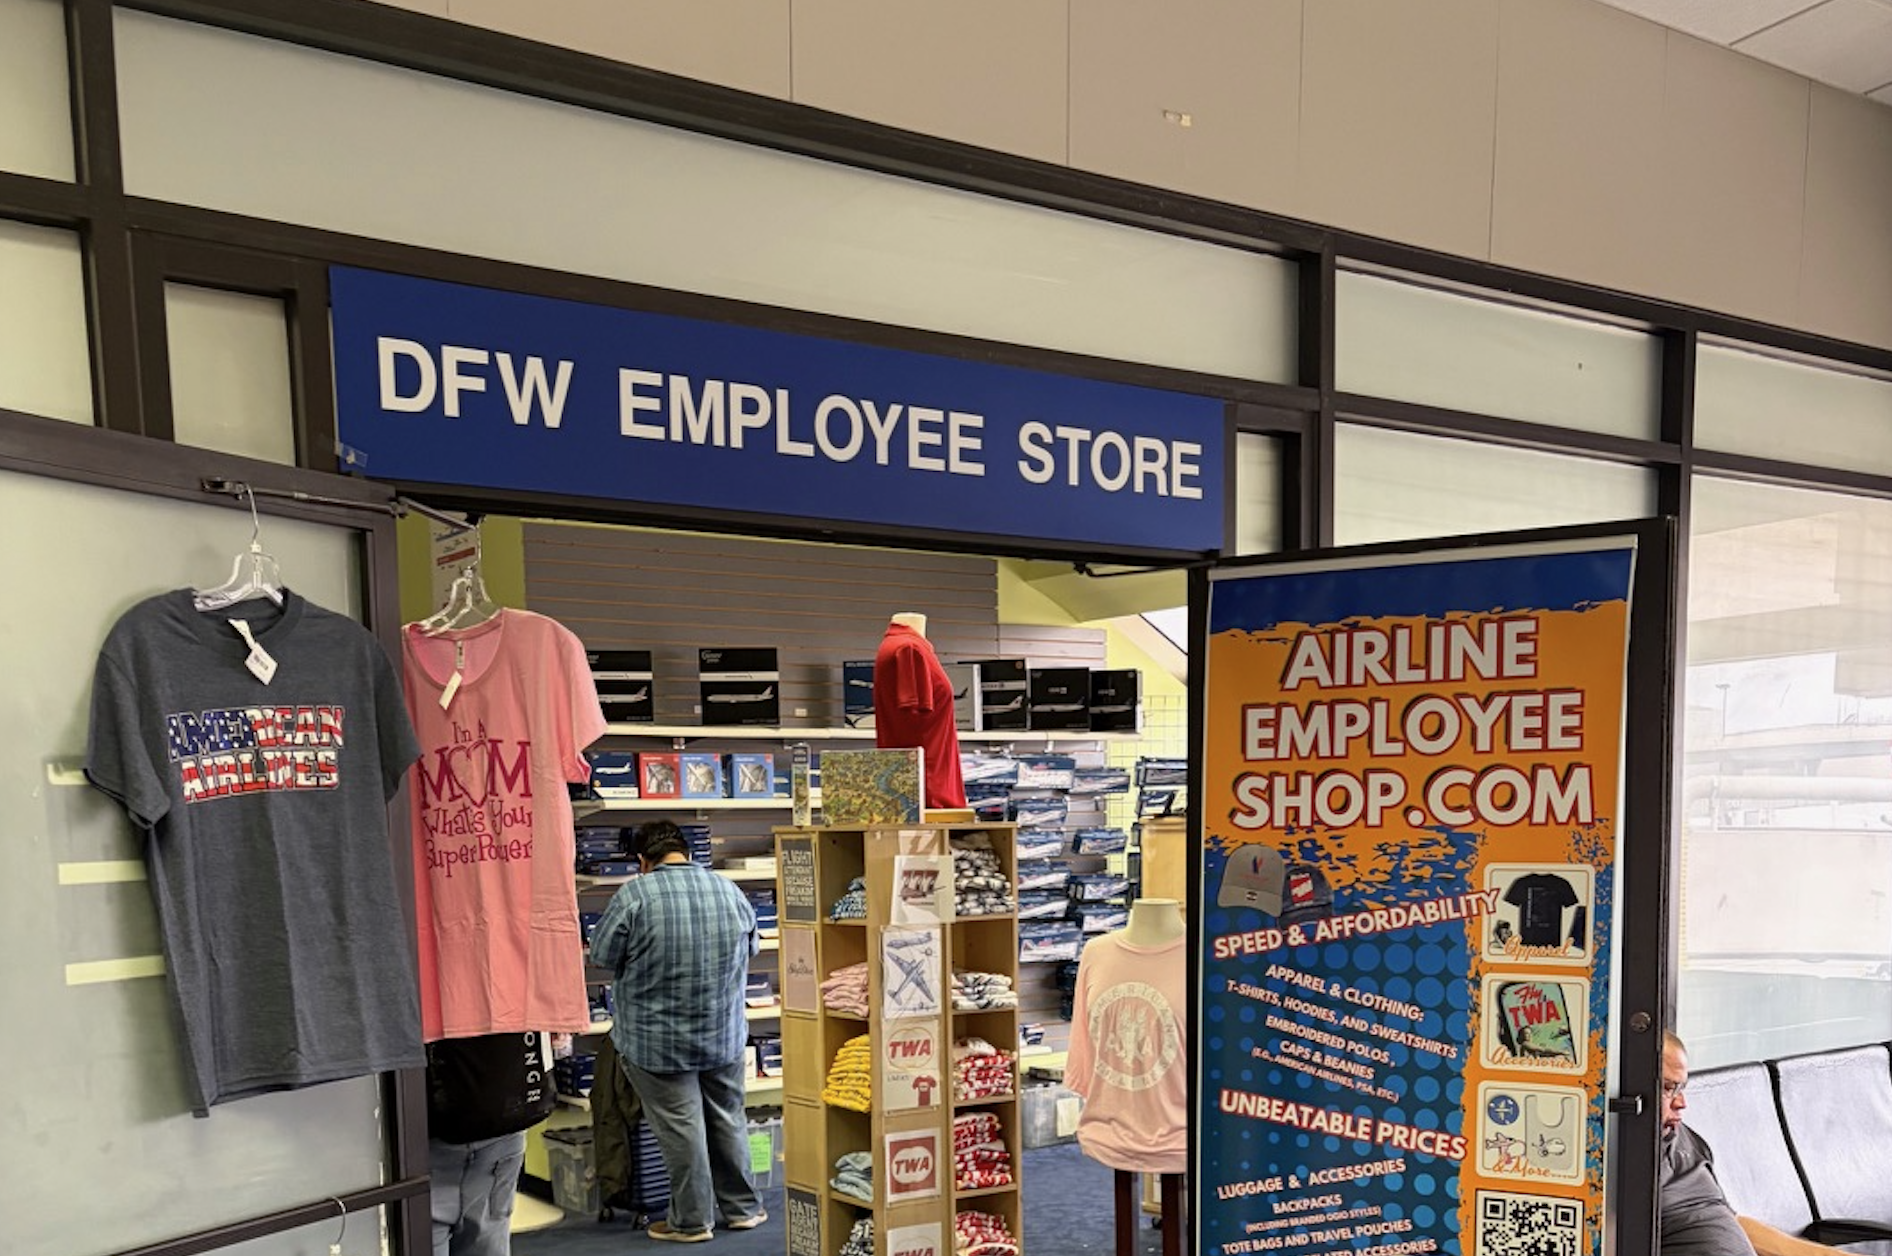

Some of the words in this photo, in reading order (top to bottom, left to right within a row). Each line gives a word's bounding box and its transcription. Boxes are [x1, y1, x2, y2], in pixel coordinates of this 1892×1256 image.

[377, 335, 574, 430] DFW
[618, 367, 986, 477] EMPLOYEE
[1018, 421, 1203, 500] STORE
[1281, 617, 1539, 690] AIRLINE
[1242, 690, 1585, 761] EMPLOYEE
[1231, 764, 1595, 830] SHOP.COM
[1213, 927, 1284, 960] SPEED
[1287, 923, 1307, 946] &
[1314, 887, 1501, 944] AFFORDABILITY
[1265, 964, 1327, 994] APPAREL
[1329, 982, 1342, 999] &
[1343, 986, 1425, 1023] CLOTHING:
[1508, 999, 1562, 1031] TWA
[1226, 979, 1282, 1007] T-SHIRTS,
[1283, 996, 1339, 1025] HOODIES,
[1340, 1015, 1369, 1033] AND
[1369, 1023, 1459, 1059] SWEATSHIRTS
[1265, 1014, 1346, 1050] EMBROIDERED
[889, 1039, 931, 1059] TWA
[1274, 1055, 1316, 1076] AMERICAN
[1280, 1040, 1312, 1060] CAPS
[1312, 1051, 1323, 1065] &
[1323, 1055, 1376, 1080] BEANIES
[1219, 1087, 1373, 1142] UNBEATABLE
[1375, 1119, 1468, 1160] PRICES
[895, 1156, 930, 1176] TWA
[1217, 1174, 1284, 1200] LUGGAGE
[1288, 1174, 1302, 1190] &
[1308, 1157, 1407, 1187] ACCESSORIES
[1272, 1194, 1343, 1214] BACKPACKS
[1222, 1240, 1253, 1255] TOTE
[1252, 1236, 1284, 1252] BAGS
[1284, 1232, 1310, 1248] AND
[1309, 1227, 1355, 1244] TRAVEL
[1355, 1219, 1413, 1237] POUCHES
